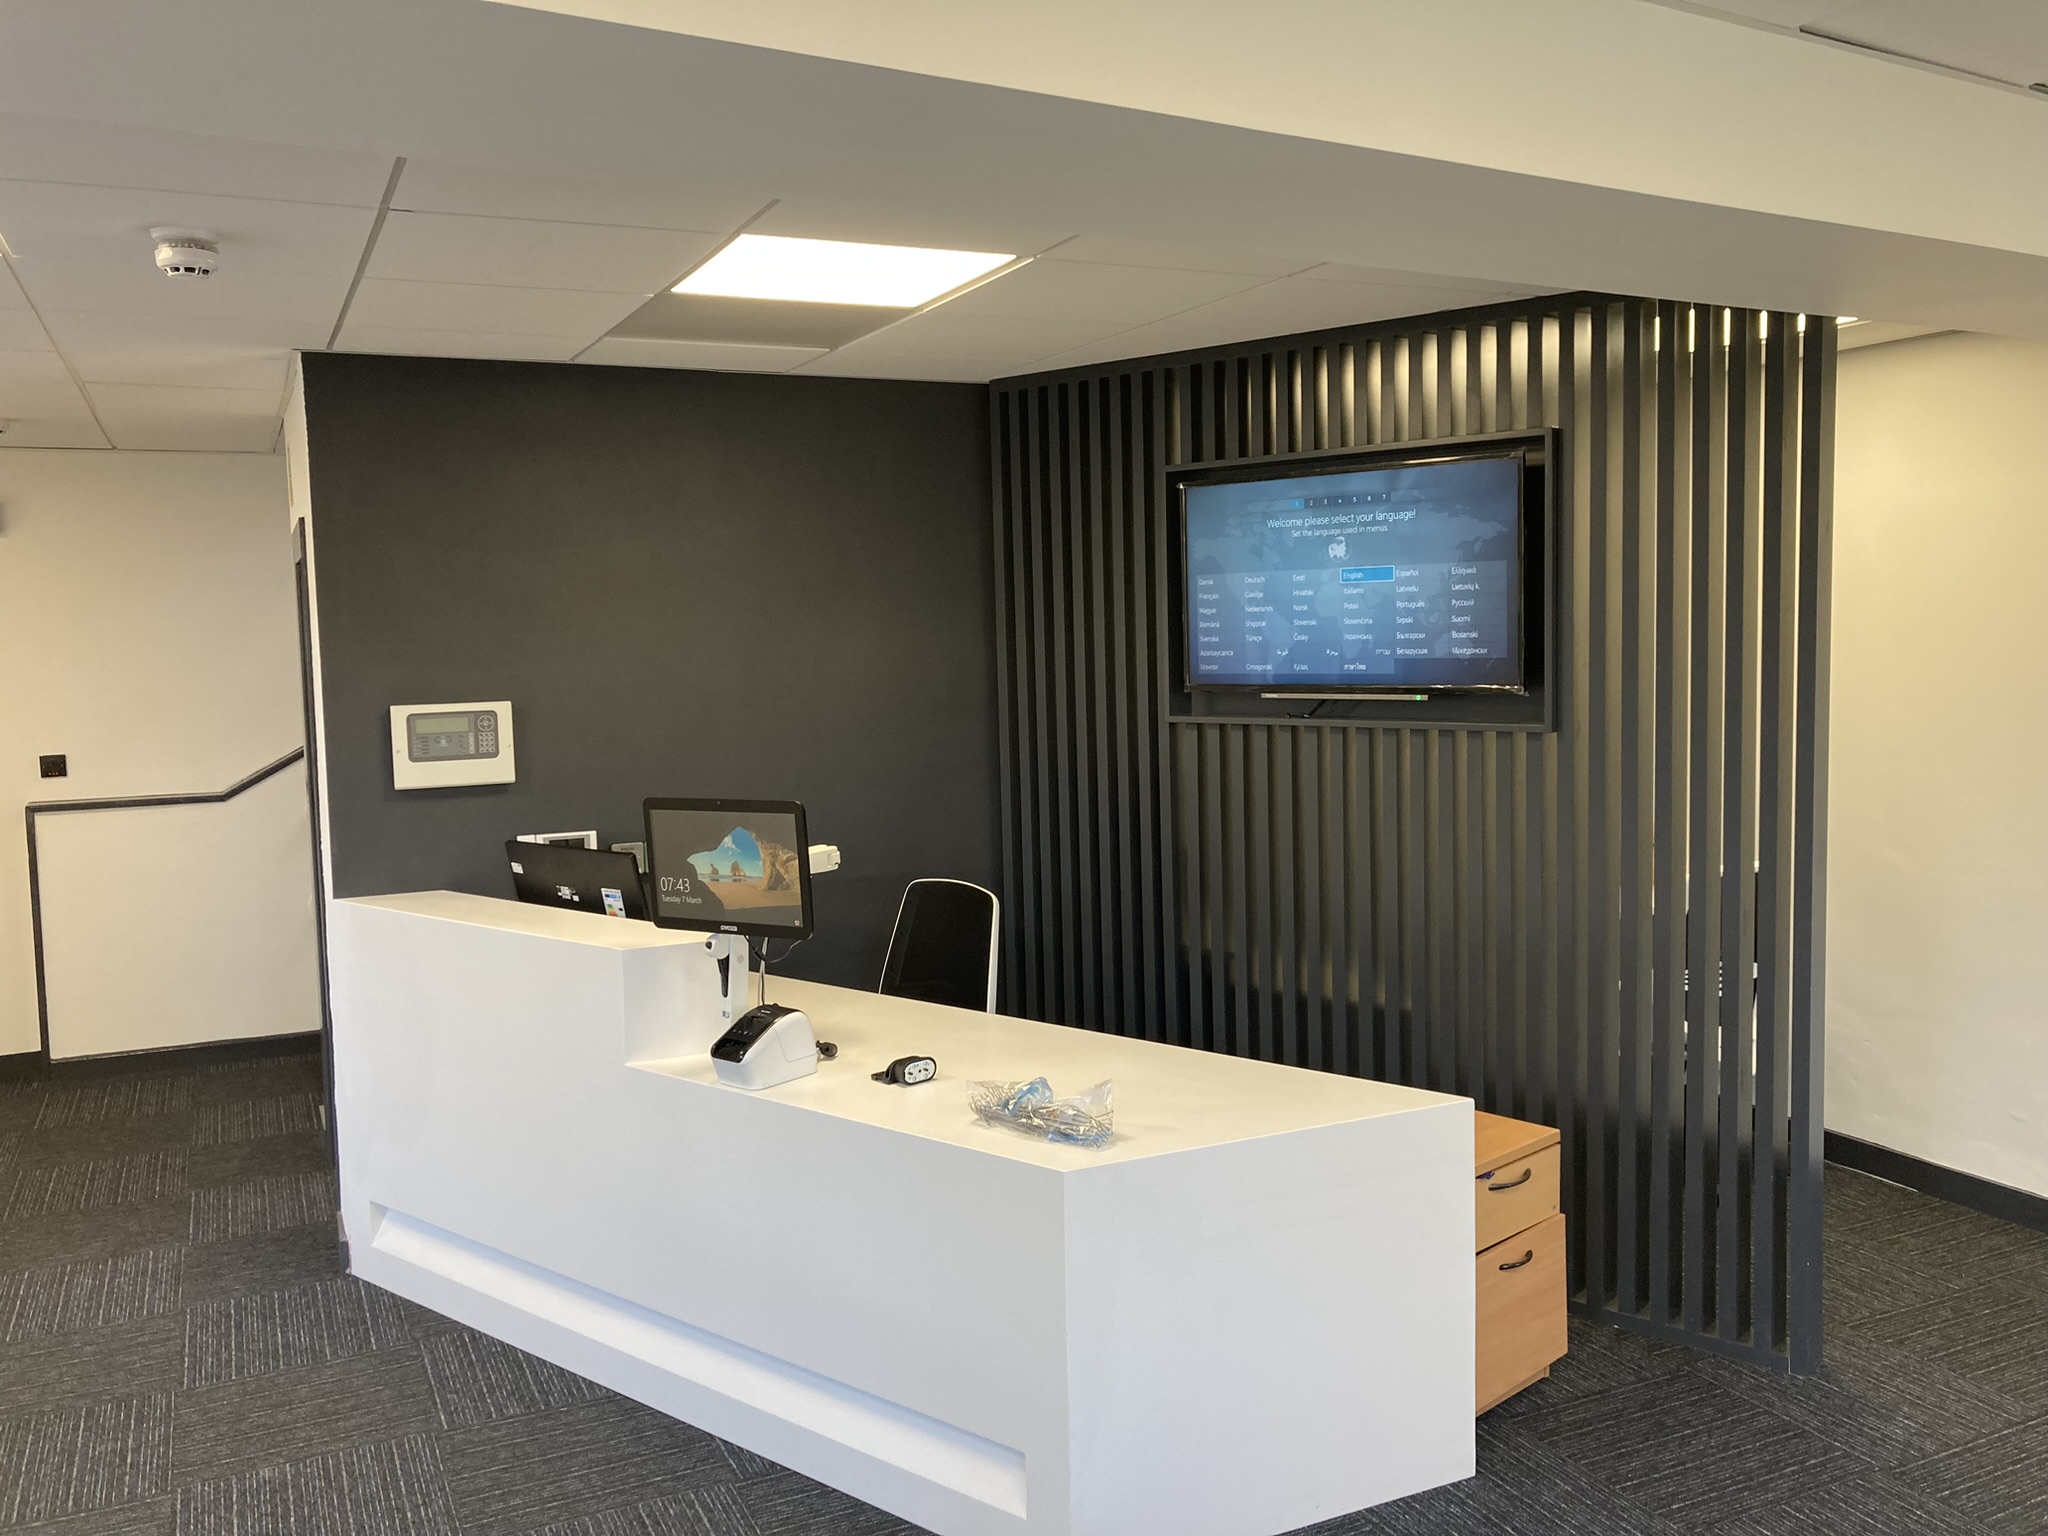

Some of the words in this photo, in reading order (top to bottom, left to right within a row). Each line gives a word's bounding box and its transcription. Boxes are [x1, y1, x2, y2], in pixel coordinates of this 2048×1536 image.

[1267, 518, 1303, 528] Welcome
[1305, 516, 1329, 530] please
[1331, 514, 1354, 524] select
[1356, 512, 1373, 524] your
[1376, 509, 1416, 523] language!
[1314, 528, 1341, 537] language
[1245, 576, 1265, 584] Deutsch
[1343, 571, 1363, 580] English
[660, 877, 690, 892] 07:43
[662, 894, 680, 904] Tuesday
